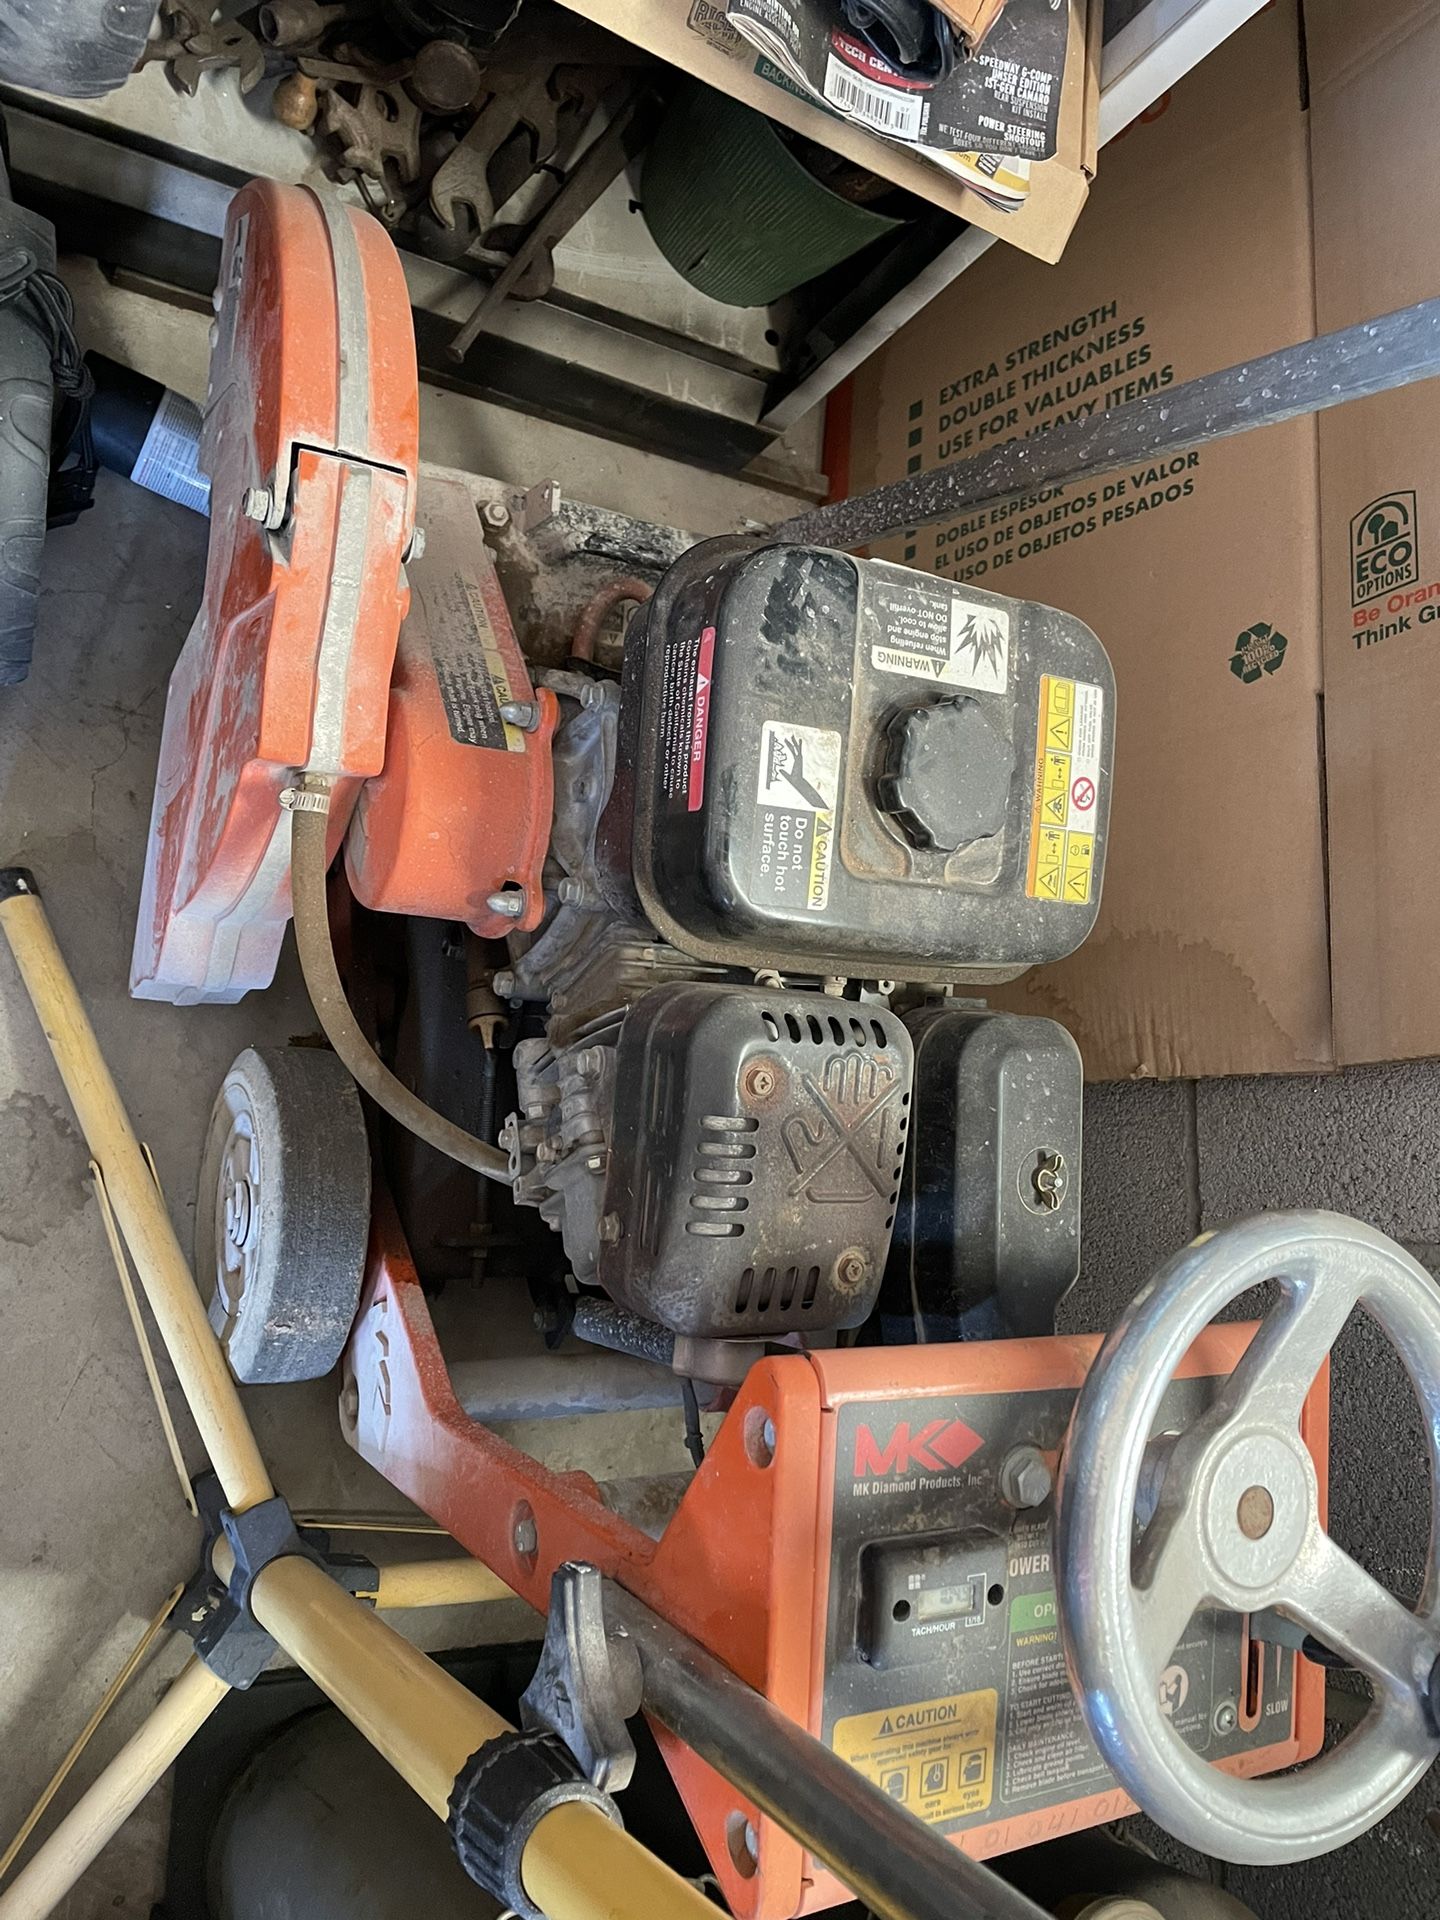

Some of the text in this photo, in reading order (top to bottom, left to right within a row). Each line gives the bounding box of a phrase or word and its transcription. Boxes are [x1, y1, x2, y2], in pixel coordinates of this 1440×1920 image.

[839, 37, 866, 62] TECH
[979, 55, 1052, 83] SPEEDWAY G-COMP
[985, 77, 1050, 105] 1ST-GEN CAMARO
[1020, 78, 1051, 95] EDITION
[994, 91, 1048, 113] REAR SUSPENSION
[1012, 106, 1047, 122] KIT INSTALL
[939, 123, 1016, 148] WE TEST FOUR DIFFERENT
[978, 115, 1045, 140] POWER STEERING
[953, 137, 972, 149] BOXES
[1004, 132, 1045, 148] SHOOTOUT
[939, 300, 1117, 405] EXTRA STRENGTH
[939, 317, 1145, 433] DOUBLE THICKNESS
[1105, 365, 1174, 410] ITEMS
[938, 343, 1151, 460] USE FOR VALUABLES
[935, 452, 1200, 570] EL USO DE OBJETOS DE VALOR
[936, 486, 1065, 548] DOBLE ESPESOR
[954, 478, 1194, 582] USO DE OBJETOS PESADOS
[1357, 541, 1412, 583] ECO
[1357, 564, 1412, 599] OPTIONS
[471, 592, 489, 630] CAUTION
[890, 602, 947, 622] DO NOT overfill
[1353, 608, 1380, 628] Be
[887, 625, 946, 644] stop engine and
[928, 623, 947, 632] allow
[1352, 616, 1412, 650] Think
[925, 644, 946, 656] When
[1243, 644, 1276, 665] 100%
[683, 640, 692, 684] contains
[878, 651, 930, 672] WARNING
[662, 644, 670, 709] reproductive
[688, 660, 696, 700] exhaust
[675, 690, 680, 699] of
[672, 703, 680, 752] California
[693, 696, 705, 762] DANGER
[684, 731, 692, 751] this
[665, 749, 669, 760] or
[671, 755, 676, 765] to
[675, 779, 681, 789] to
[760, 813, 775, 877] surface.
[774, 815, 792, 892] touch hot
[791, 817, 808, 870] Do not
[812, 841, 827, 906] CAUTION
[853, 1419, 949, 1477] MK
[853, 1482, 869, 1497] MK
[872, 1478, 916, 1495] Diamond
[912, 1622, 956, 1637] TACH/HOUR
[1016, 1632, 1057, 1647] WARNING!
[1012, 1658, 1039, 1669] BEFORE
[1019, 1669, 1031, 1677] Use
[1020, 1698, 1041, 1708] START
[1266, 1699, 1289, 1716] SLOW
[896, 1704, 957, 1729] CAUTION
[1028, 1731, 1074, 1748] MAINTENANCE
[870, 1744, 900, 1759] operating
[877, 1754, 907, 1766] approved
[908, 1749, 927, 1760] safety
[1013, 1759, 1032, 1769] Check
[1034, 1755, 1046, 1764] and
[1014, 1750, 1033, 1760] Check
[1034, 1745, 1055, 1757] engine
[1012, 1770, 1046, 1785] Check belt
[1013, 1764, 1042, 1777] Lubricate
[1043, 1759, 1064, 1771] grease
[1012, 1782, 1037, 1794] Remove
[1038, 1777, 1056, 1787] blade
[1057, 1772, 1076, 1782] before
[925, 1799, 941, 1809] ears
[963, 1789, 980, 1800] eyes
